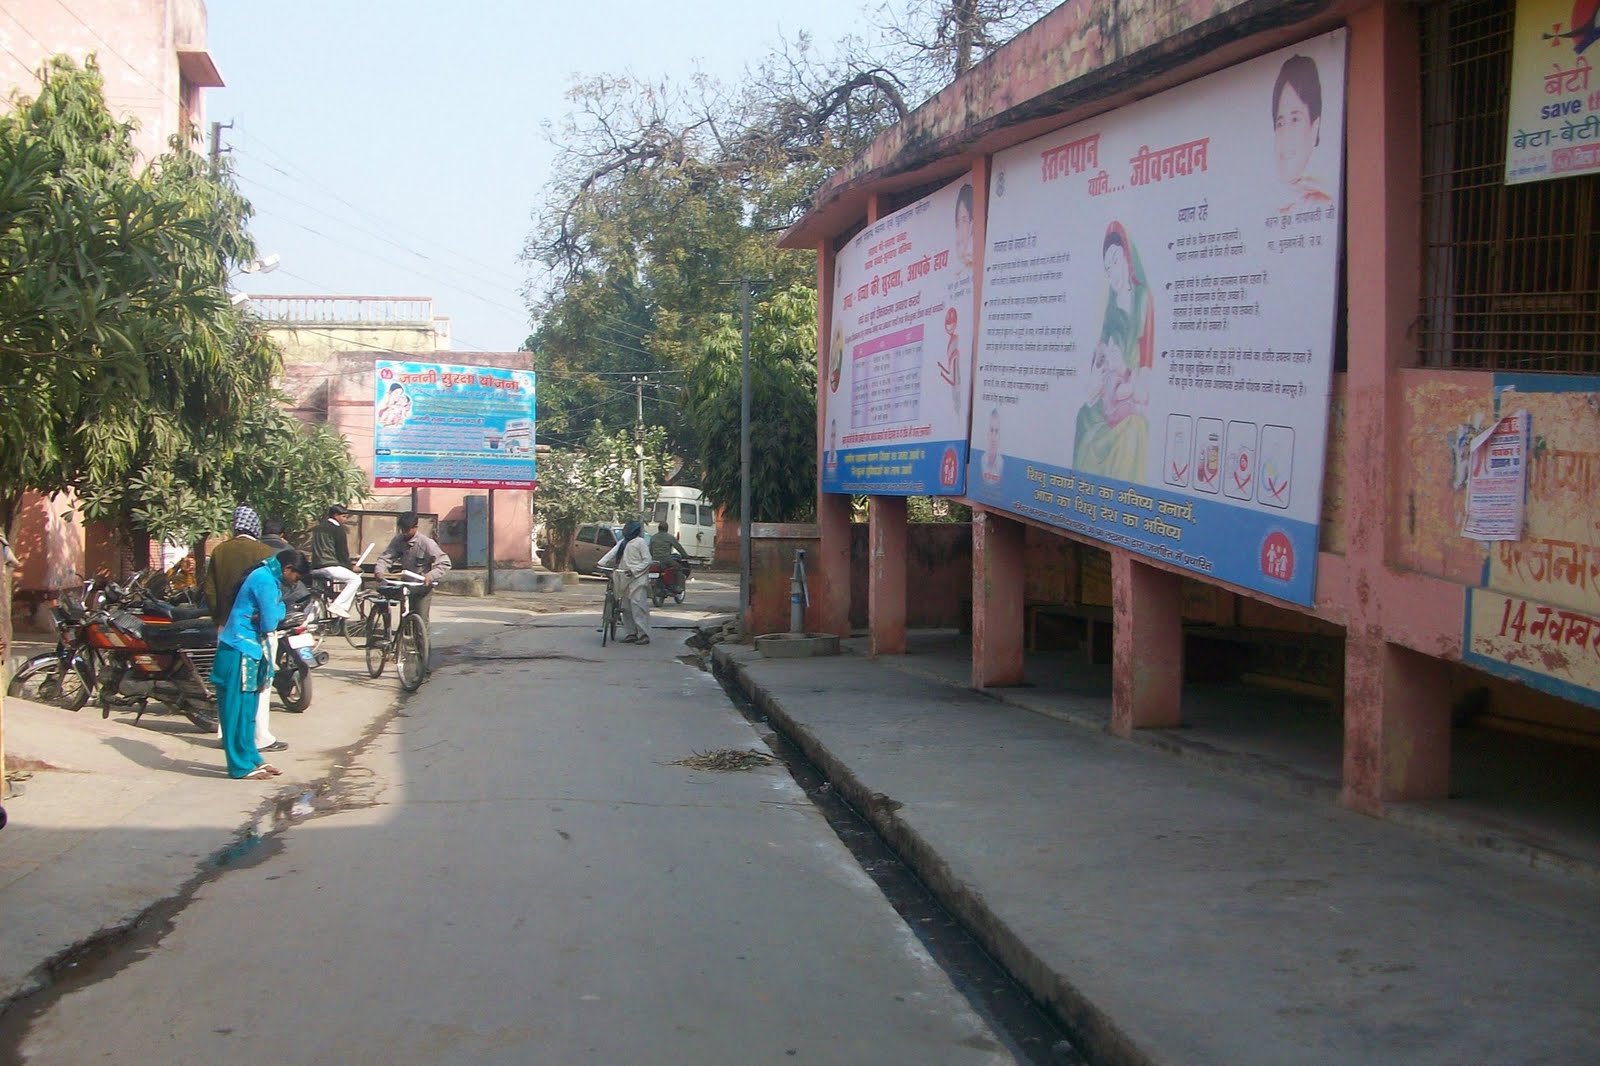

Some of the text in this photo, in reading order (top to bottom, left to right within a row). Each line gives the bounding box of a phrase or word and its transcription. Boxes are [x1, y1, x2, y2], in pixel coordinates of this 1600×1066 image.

[1544, 56, 1592, 95] बेटी
[1541, 99, 1582, 120] save
[1513, 115, 1600, 149] बेटा-बेटी
[1041, 133, 1100, 182] स्तनपान
[1129, 136, 1210, 186] जीवनदान
[1178, 206, 1196, 222] ध्यान
[906, 254, 931, 282] आपके
[934, 250, 950, 272] हाथ
[400, 370, 520, 391] जननी सुरक्षा योजना
[1027, 465, 1046, 488] शिशु
[1078, 479, 1094, 496] देश
[1099, 485, 1114, 500] का
[1118, 488, 1153, 511] भविष्य
[1034, 489, 1182, 542] आज का शिशु देश का भविष्य
[1499, 599, 1526, 643] 14
